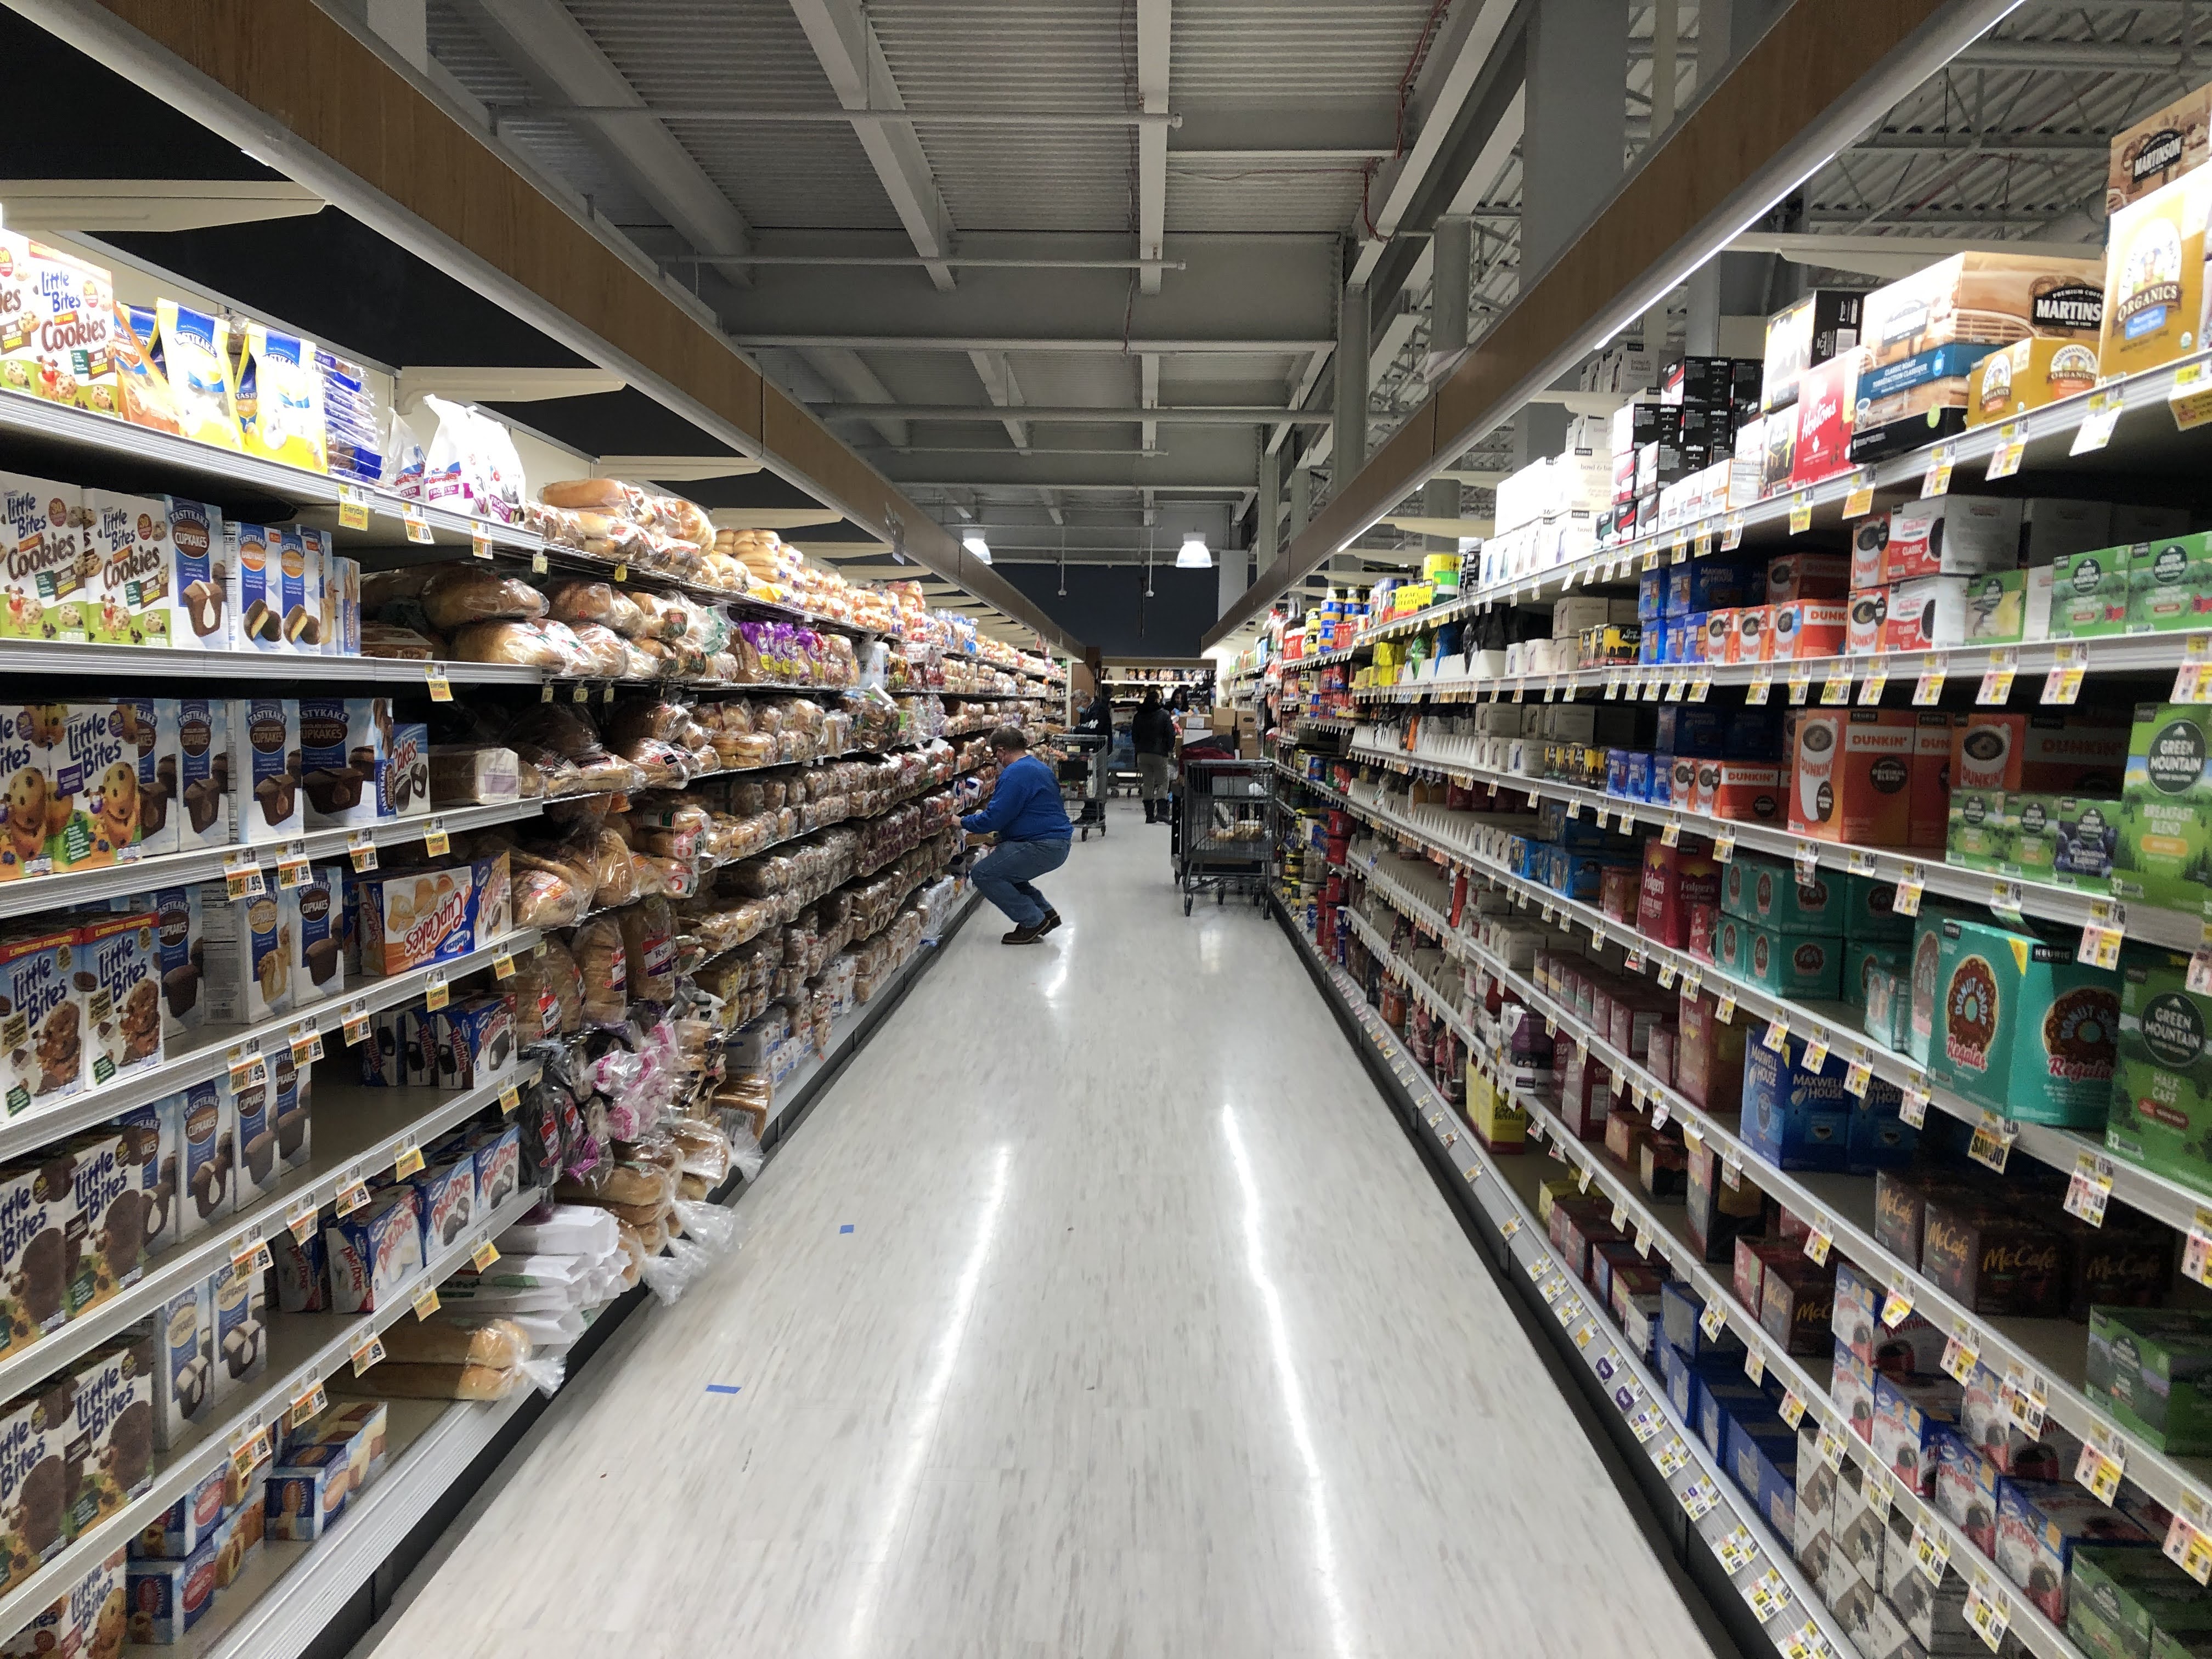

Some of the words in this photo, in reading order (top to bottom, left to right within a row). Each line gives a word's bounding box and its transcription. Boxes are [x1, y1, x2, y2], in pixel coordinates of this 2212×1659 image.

[2134, 137, 2182, 177] MARTINSON
[42, 270, 69, 296] Little
[52, 290, 81, 313] Bites
[2036, 298, 2102, 321] MARTINS
[2117, 283, 2178, 323] ORGANICS
[41, 313, 106, 353] Cookies
[1801, 399, 1837, 443] Hortons
[7, 492, 36, 524] Little
[170, 509, 210, 529] TASTYKAKE
[344, 505, 365, 517] Everyday
[18, 515, 47, 539] Bites
[104, 509, 127, 539] Little
[111, 528, 136, 552] Bites
[175, 532, 207, 549] CUPKAKES
[1902, 543, 1923, 556] CLASSIC
[7, 532, 76, 582] Cookies
[104, 545, 160, 591] Cookies
[249, 709, 287, 726] TASTYKAKE
[300, 709, 350, 724] ASTYKAKE
[67, 712, 106, 761] Little
[252, 731, 284, 744] CUPKAKES
[301, 728, 343, 741] UPKAKES
[1851, 734, 1908, 747] DUNKIN'
[82, 738, 122, 779] Bites
[2159, 740, 2194, 757] GREEN
[1728, 771, 1774, 782] DUNKIN'
[2150, 755, 2202, 772] MOUNTAIN
[2143, 804, 2193, 822] BREAKFAST
[2151, 820, 2182, 836] BLEND
[1644, 871, 1665, 897] Folgers
[1680, 880, 1715, 894] Folgers
[302, 899, 330, 917] CUPKAKES
[98, 935, 134, 988] Little
[2035, 947, 2072, 960] KEURIG
[13, 953, 51, 1011] Little
[111, 957, 146, 1003] Bites
[27, 978, 67, 1029] Bites
[1955, 977, 1977, 1015] DONUT
[1976, 980, 1988, 1027] SHOP
[2155, 1007, 2193, 1028] GREEN
[2145, 1022, 2201, 1049] MOUNTAIN
[1751, 1044, 1778, 1075] MAXWELL
[1946, 1034, 1988, 1073] Regular
[1755, 1068, 1778, 1087] HOUSE
[2152, 1073, 2181, 1091] HALF
[240, 1093, 264, 1111] CUPKAKES
[75, 1152, 114, 1209] Little
[88, 1168, 127, 1223] Bites
[1, 1206, 47, 1263] Bites
[76, 1367, 119, 1431] Little
[91, 1380, 136, 1441] Bites
[1, 1436, 45, 1500] Bites
[81, 1570, 114, 1633] Bites
